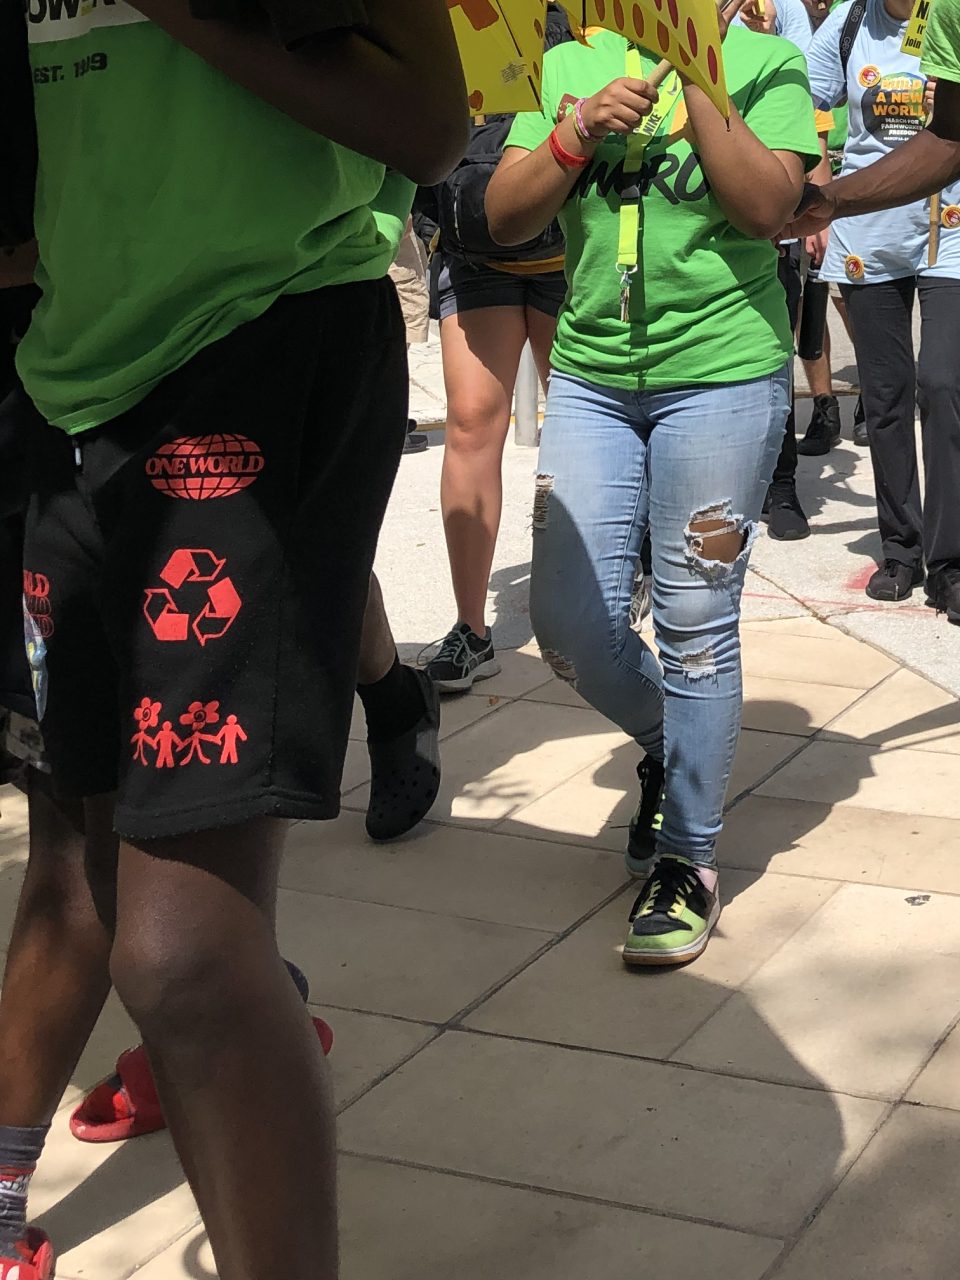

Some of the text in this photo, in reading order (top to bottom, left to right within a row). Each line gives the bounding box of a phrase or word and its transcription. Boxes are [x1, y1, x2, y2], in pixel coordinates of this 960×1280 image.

[875, 91, 923, 103] A NEW
[643, 113, 663, 136] NIKE
[145, 455, 265, 476] ONE WORLD
